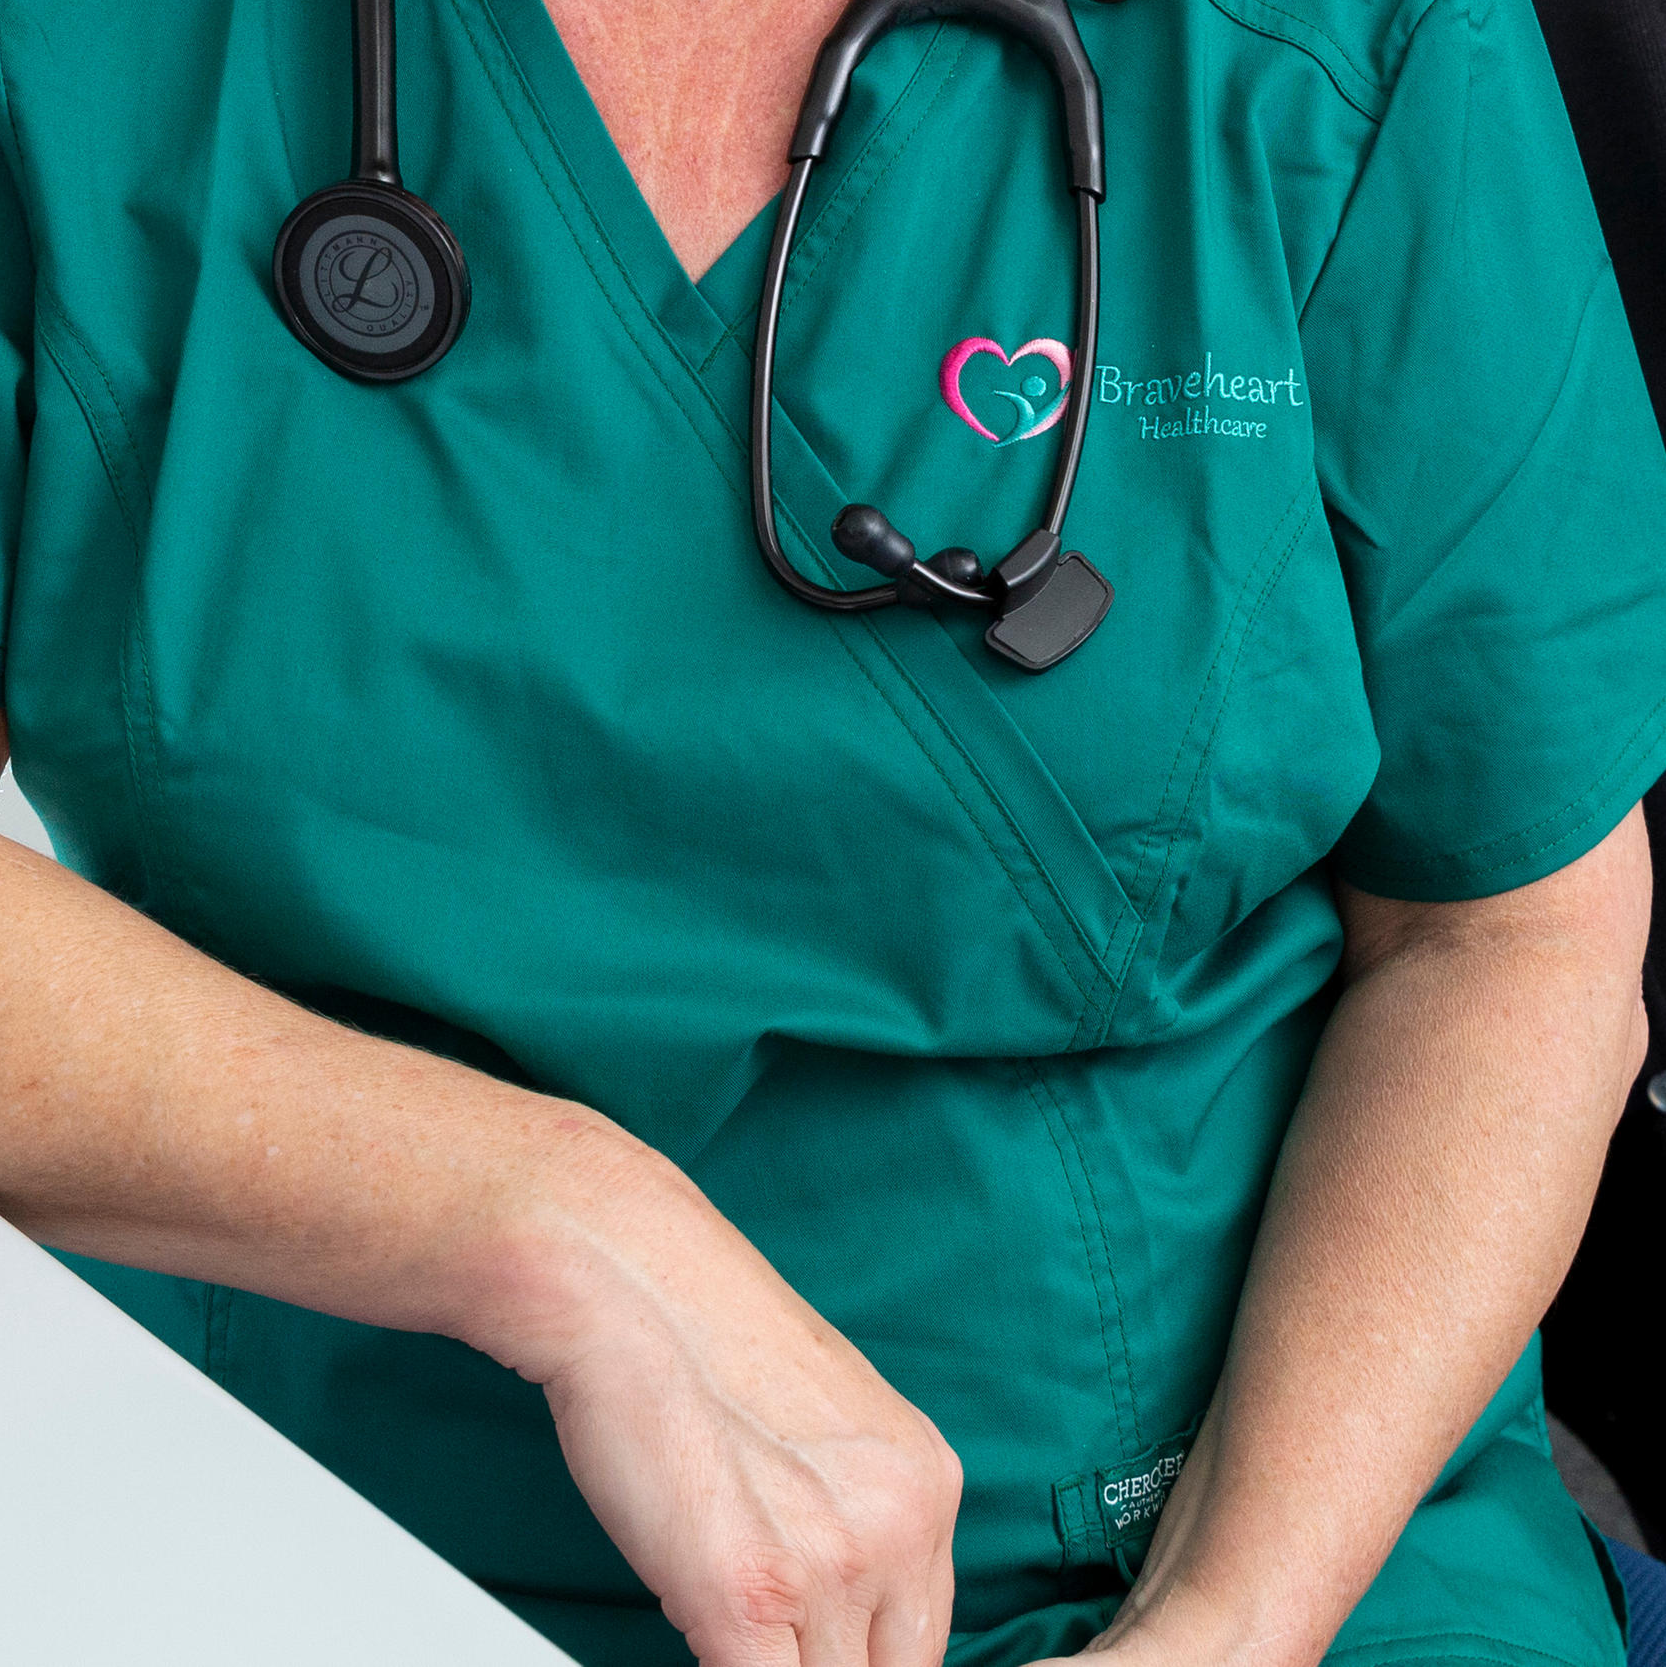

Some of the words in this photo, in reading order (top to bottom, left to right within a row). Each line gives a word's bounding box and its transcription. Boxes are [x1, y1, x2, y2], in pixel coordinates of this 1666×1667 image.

[320, 235, 378, 298] LITTMANN
[366, 279, 414, 333] QUALITY
[1096, 351, 1304, 407] Braveheart
[1137, 405, 1268, 440] Healthcare
